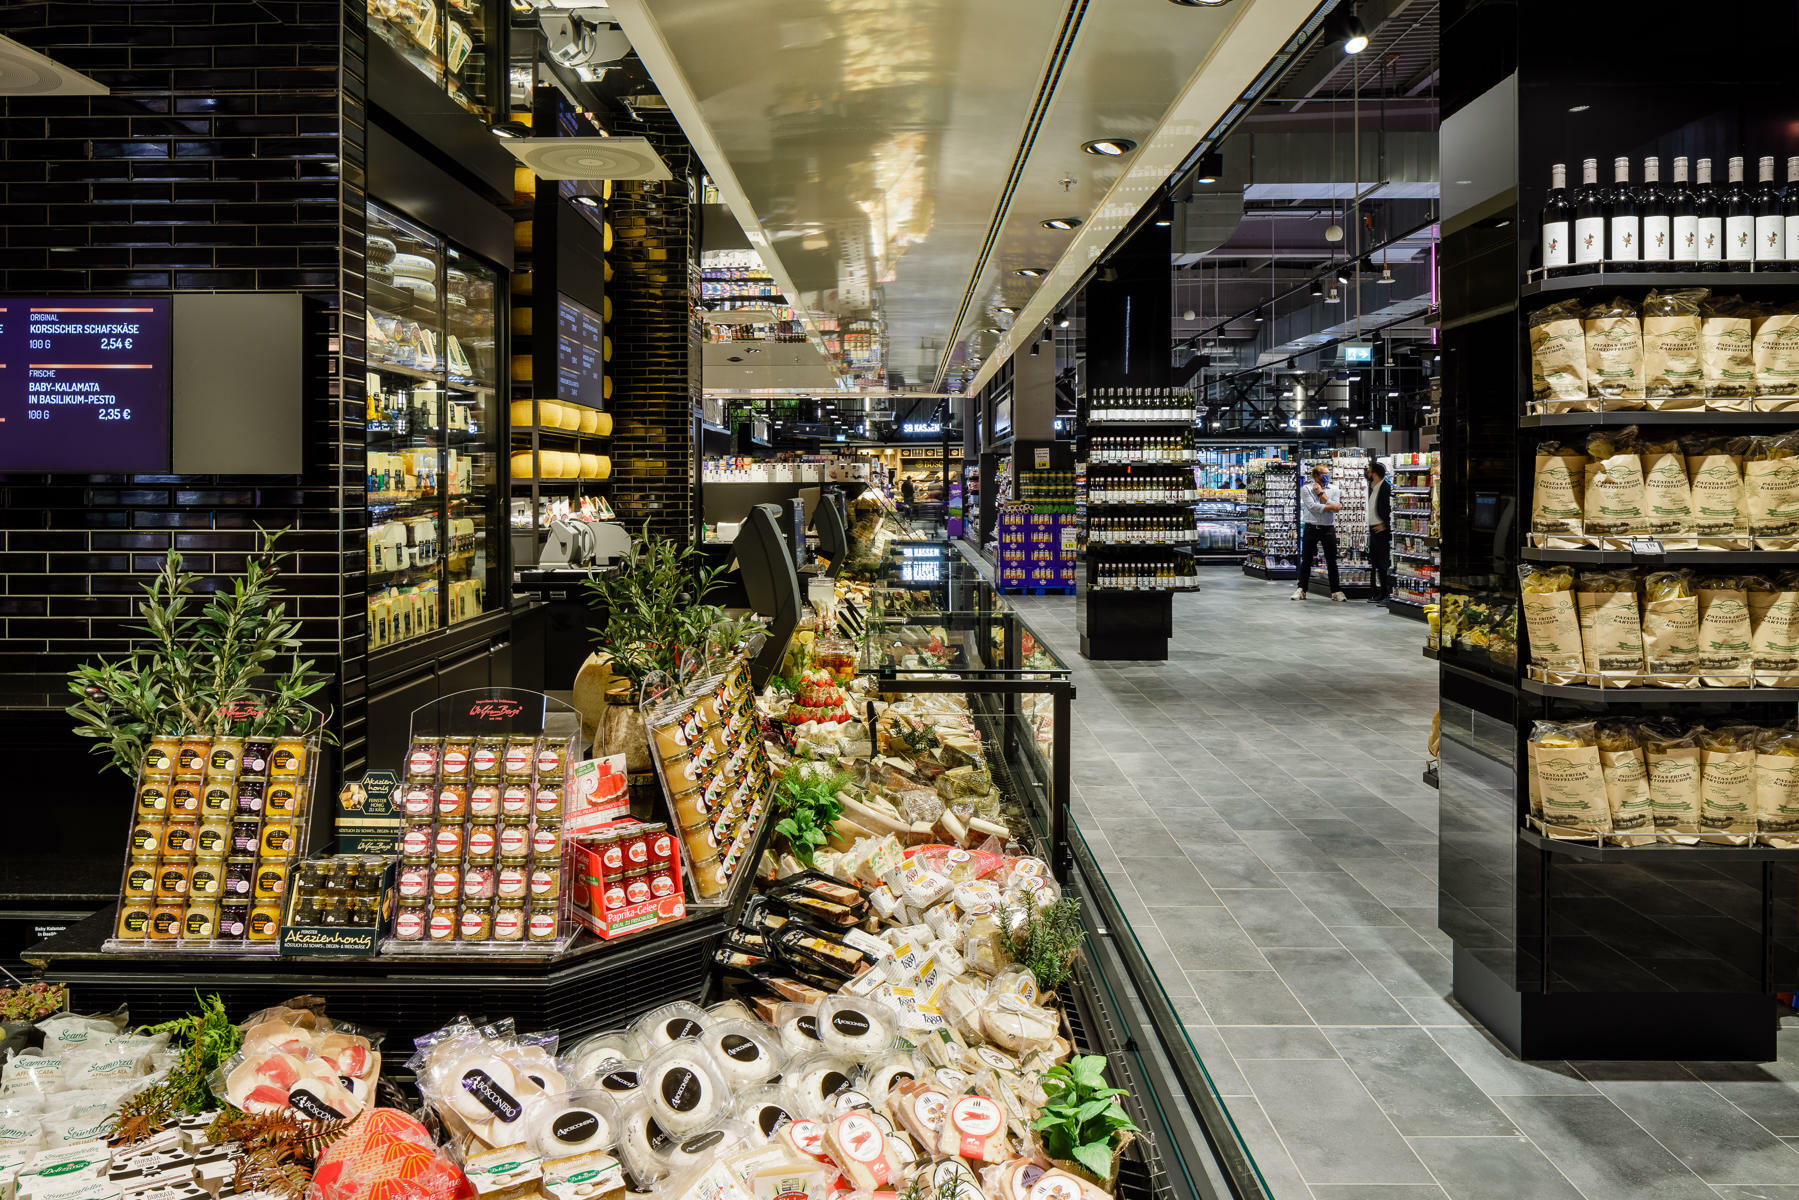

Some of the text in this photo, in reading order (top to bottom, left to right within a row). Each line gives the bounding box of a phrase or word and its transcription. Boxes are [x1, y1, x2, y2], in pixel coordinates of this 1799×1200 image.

[30, 314, 59, 322] ORIGINAL
[30, 322, 140, 334] KORSISCHER SCHAFSKÄSE
[29, 339, 51, 349] 100 G
[100, 338, 133, 350] 2,54 €
[29, 370, 56, 378] FRISCHE
[28, 382, 100, 392] BABY-KALAMATA
[28, 394, 116, 405] IN BASILIKUM-PESTO
[28, 410, 50, 420] 100 G
[98, 408, 131, 421] 2,35 €
[607, 903, 658, 923] Paprika-Gelee
[285, 929, 372, 950] Akazienhonig
[477, 1081, 517, 1117] BOSCONERO
